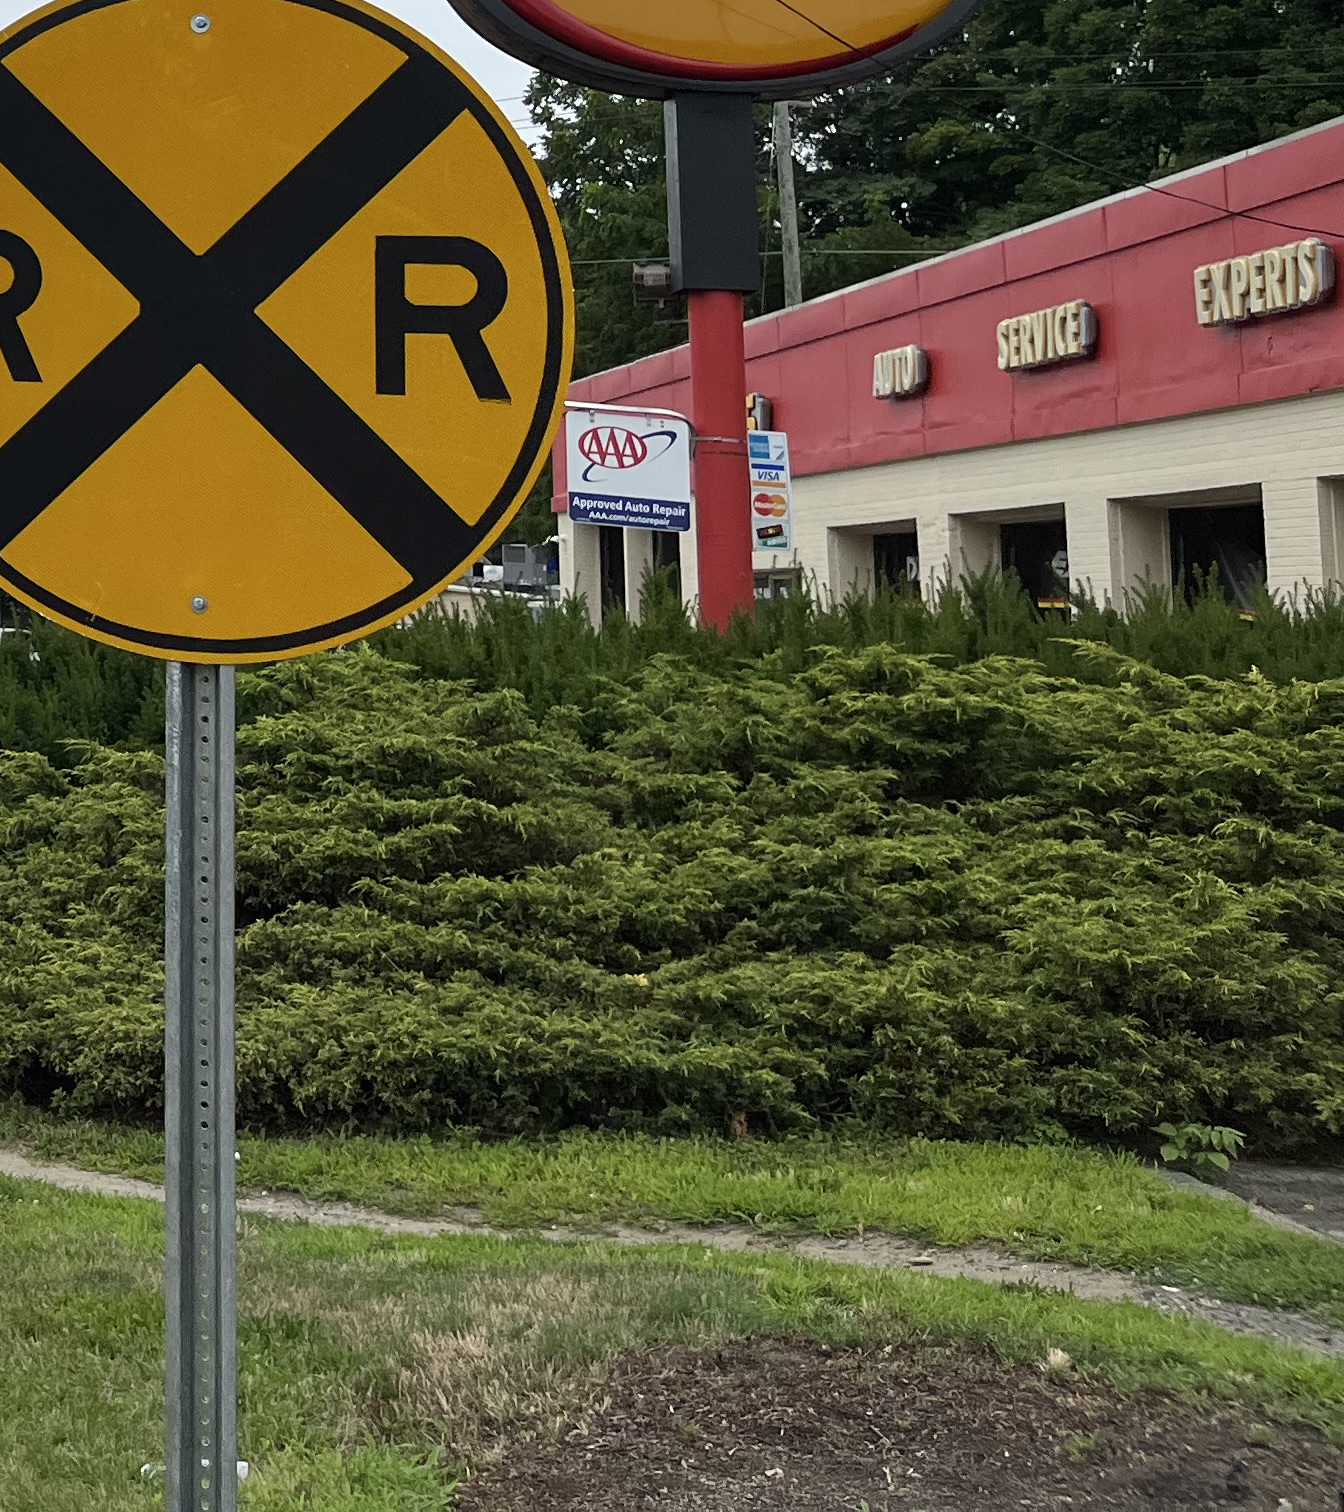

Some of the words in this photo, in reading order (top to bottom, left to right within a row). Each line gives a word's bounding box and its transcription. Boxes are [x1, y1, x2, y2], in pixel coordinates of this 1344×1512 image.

[1194, 238, 1326, 327] EXPERTS
[374, 234, 513, 404] R
[997, 299, 1091, 371] SERVICE
[873, 344, 922, 399] AUTO
[586, 427, 640, 469] AAA
[757, 470, 780, 482] VISA
[572, 496, 623, 511] Approved
[624, 501, 650, 514] Auto
[652, 503, 686, 517] Repair
[588, 510, 671, 526] AAA.com/autorepair
